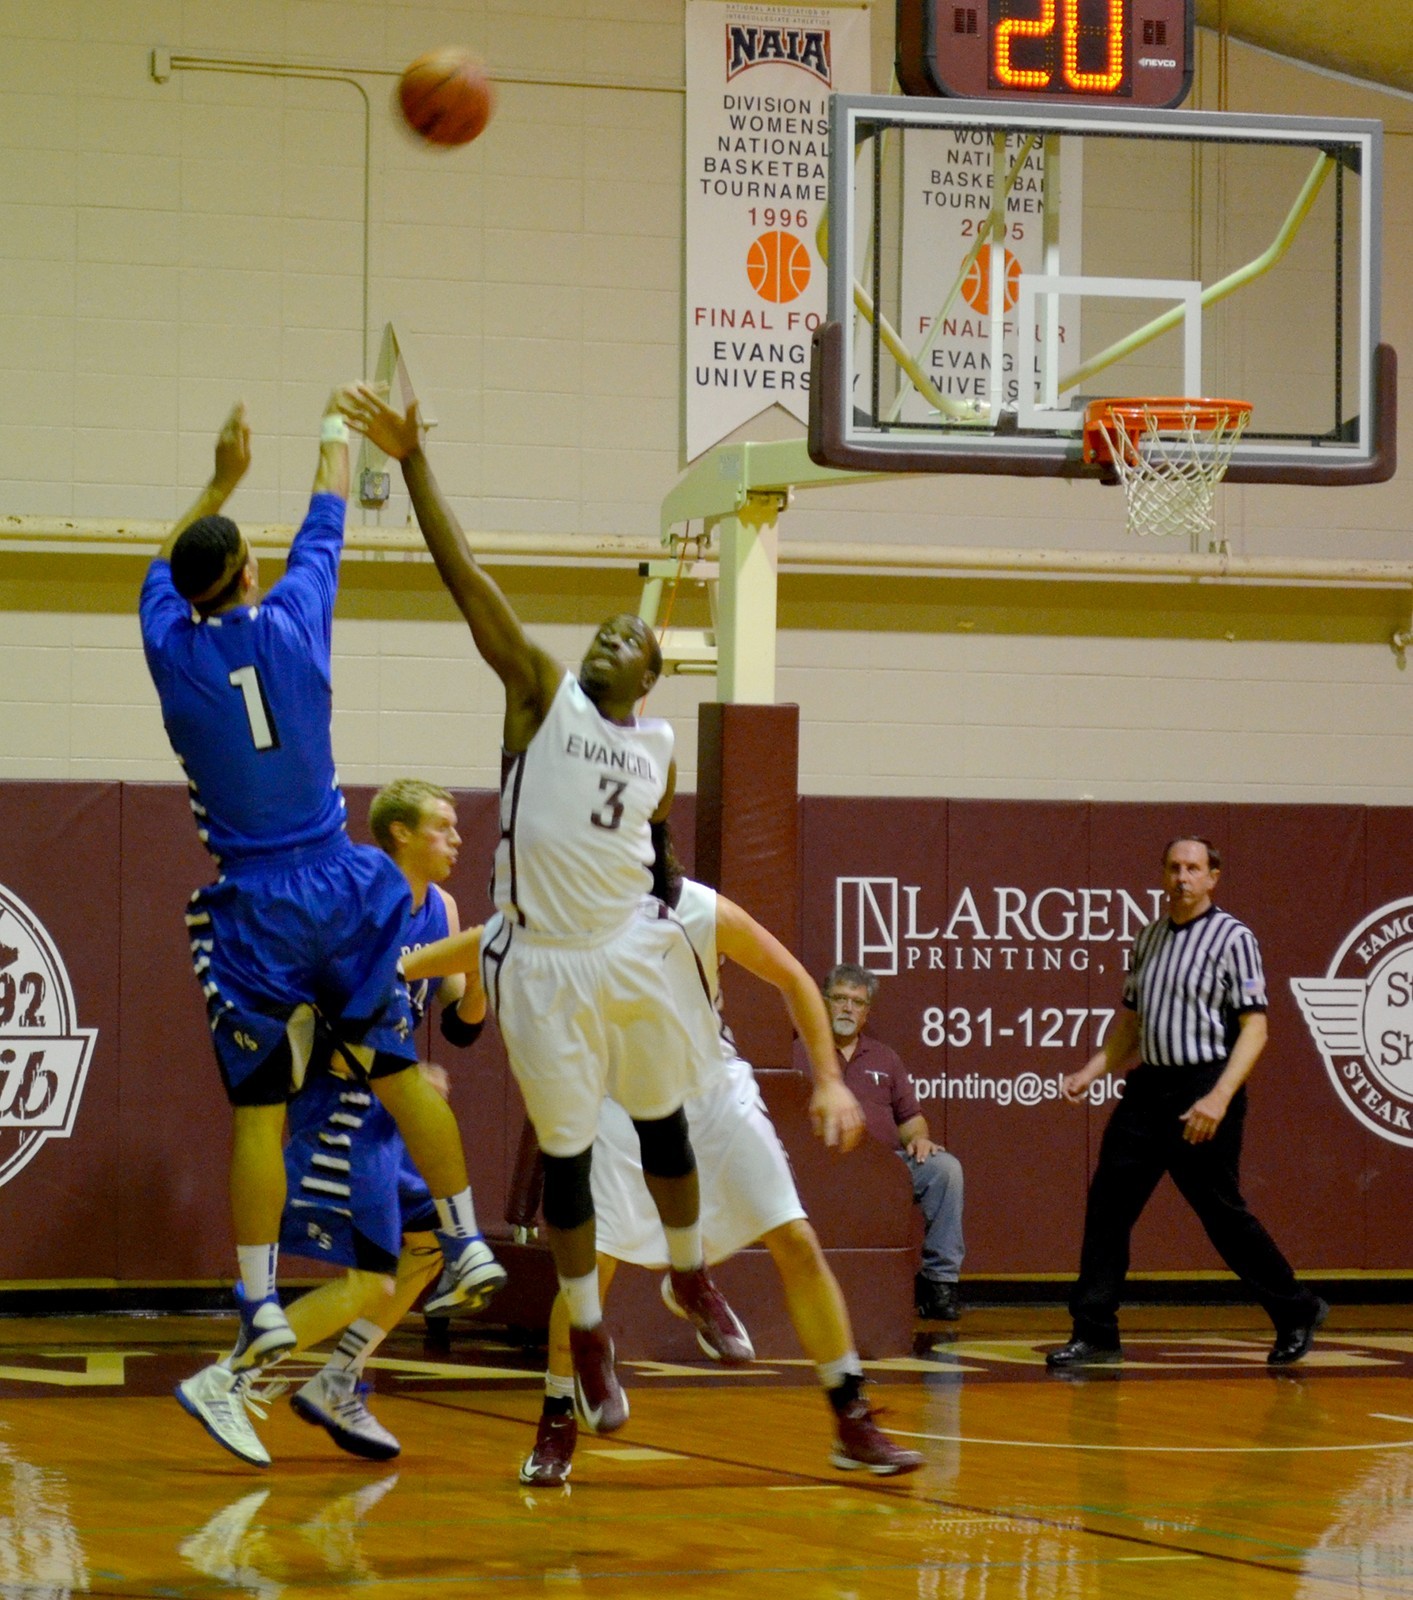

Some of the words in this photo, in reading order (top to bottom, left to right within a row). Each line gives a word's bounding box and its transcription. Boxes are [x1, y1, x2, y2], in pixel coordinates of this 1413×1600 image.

[730, 26, 829, 78] NAIA
[996, 0, 1123, 91] 20
[724, 95, 811, 114] DIVISION
[730, 115, 828, 135] WOMENS
[719, 137, 829, 157] NATIONAL
[704, 157, 825, 179] BASKETBA
[947, 149, 1044, 171] NATINAL
[700, 179, 827, 200] TOURNAME
[922, 190, 1045, 213] TOURNMEN
[749, 207, 808, 228] 1996
[694, 307, 773, 330] FINAL
[788, 312, 821, 332] FO
[919, 316, 989, 338] FNAL
[714, 341, 805, 364] EVANG
[932, 350, 1041, 373] EVANGL
[696, 366, 860, 391] UNIVERS
[229, 665, 281, 752] 1
[566, 733, 657, 784] EVANGEL
[590, 776, 628, 830] 3
[902, 886, 1170, 942] LARGEN
[906, 946, 1105, 974] PRINTING,
[922, 1006, 1116, 1048] 831-1277
